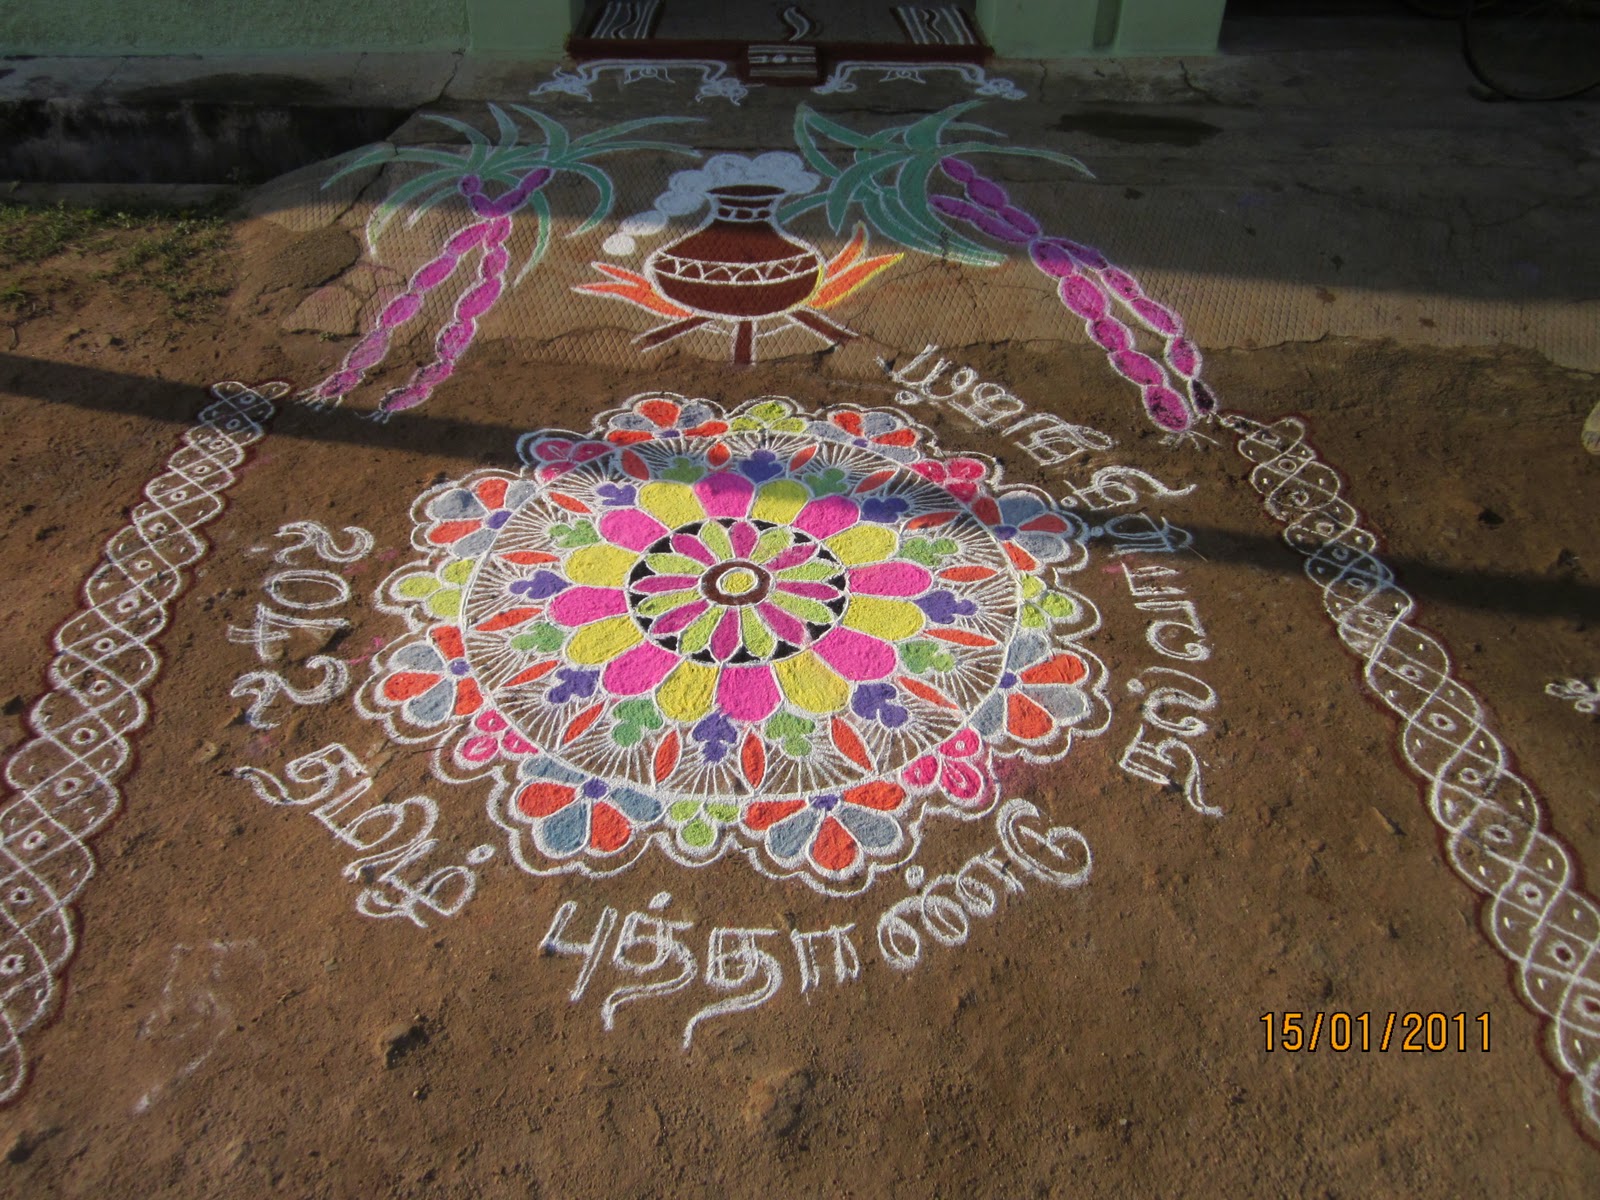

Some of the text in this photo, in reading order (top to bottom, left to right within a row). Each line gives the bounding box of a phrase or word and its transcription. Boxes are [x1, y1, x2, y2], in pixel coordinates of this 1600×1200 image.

[227, 520, 374, 730] 2042
[233, 742, 496, 929] தமிழ்
[540, 798, 1093, 1051] புத்தாண்டு
